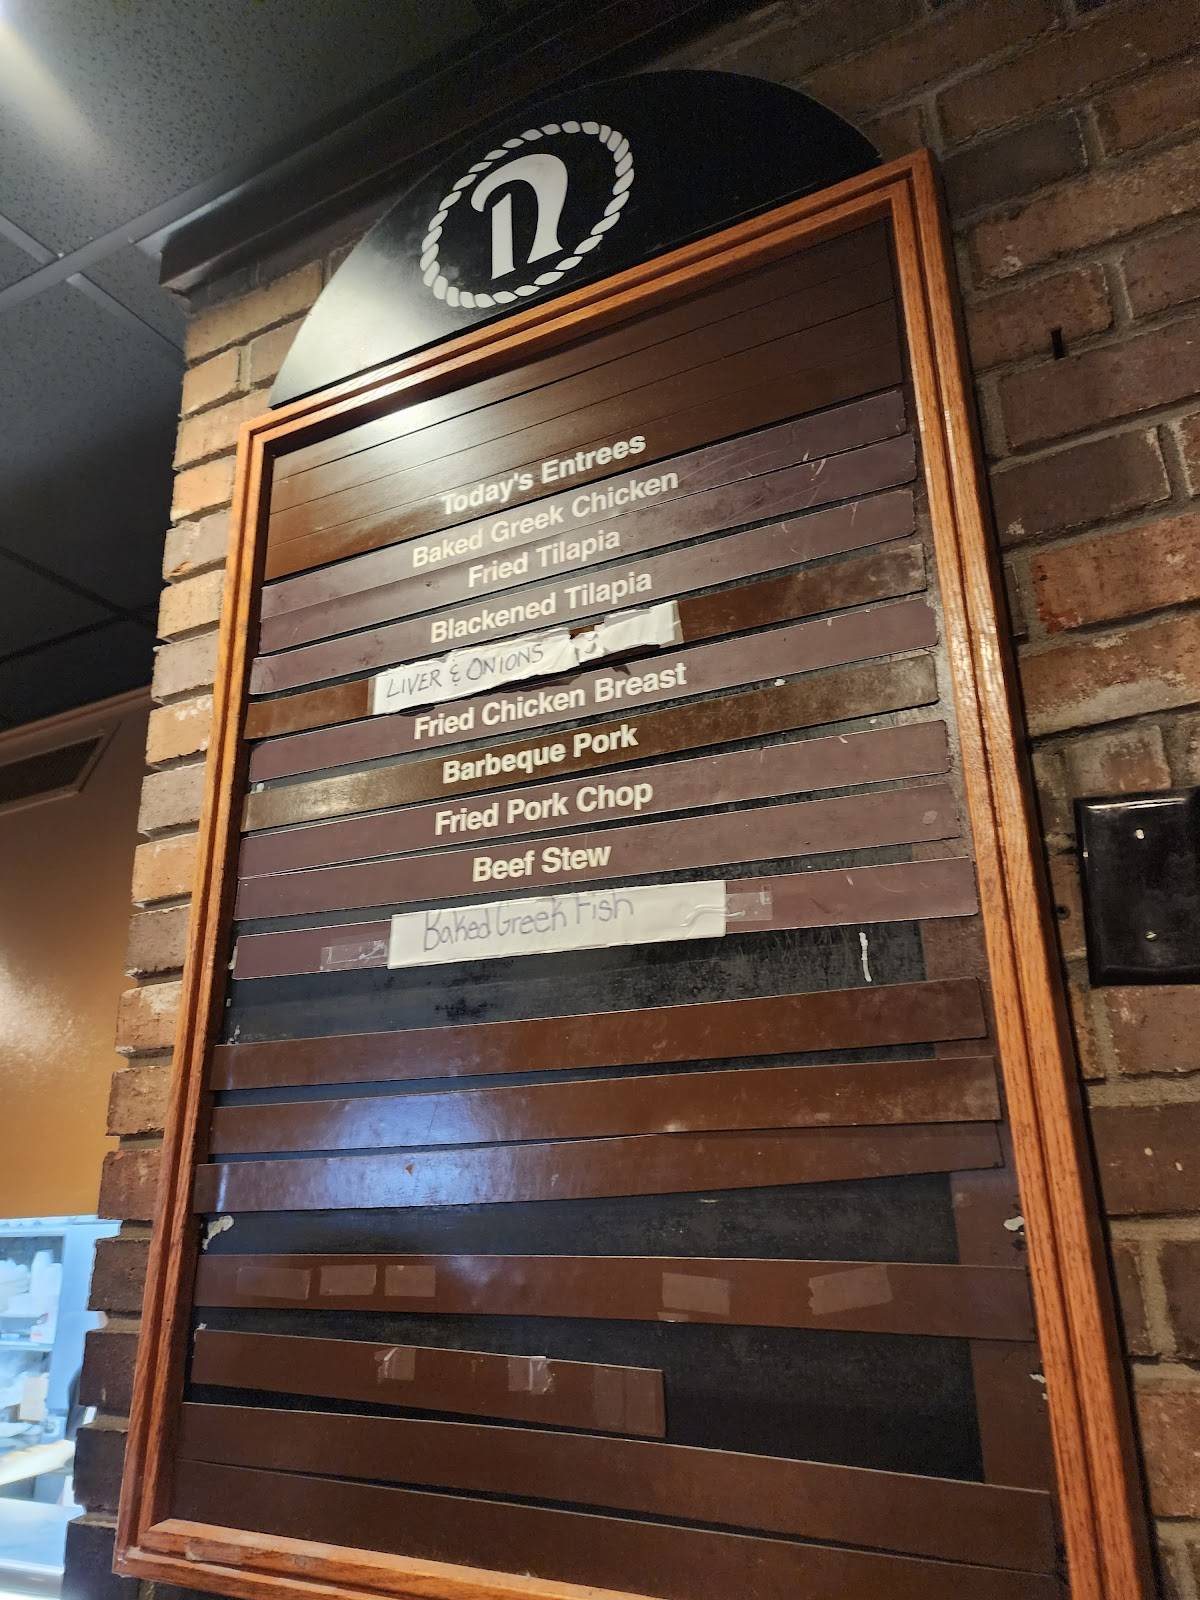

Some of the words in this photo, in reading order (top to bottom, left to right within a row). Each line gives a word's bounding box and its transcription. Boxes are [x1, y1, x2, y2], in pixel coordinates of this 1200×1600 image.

[441, 472, 533, 515] Today's
[541, 434, 647, 484] Entrees
[412, 530, 482, 568] Baked
[491, 505, 564, 543] Greek
[571, 471, 679, 518] Chicken
[468, 551, 528, 588] Fried
[536, 529, 621, 568] Tilapia
[430, 593, 556, 644] Blackened
[565, 572, 653, 609] Tilapia
[387, 668, 441, 698] LIVER
[450, 659, 461, 687] &
[466, 643, 545, 682] ONIONS
[414, 706, 474, 740] Fried
[481, 687, 586, 726] Chicken
[594, 662, 688, 702] Breast
[442, 743, 566, 784] Barbeque
[573, 724, 639, 758] Pork
[435, 803, 499, 836] Fried
[506, 792, 570, 824] Pork
[576, 782, 654, 813] Chop
[472, 850, 535, 883] Beef
[541, 844, 612, 874] Stew
[423, 910, 491, 952] Baked
[495, 897, 567, 936] Greek
[574, 893, 634, 925] Fish
